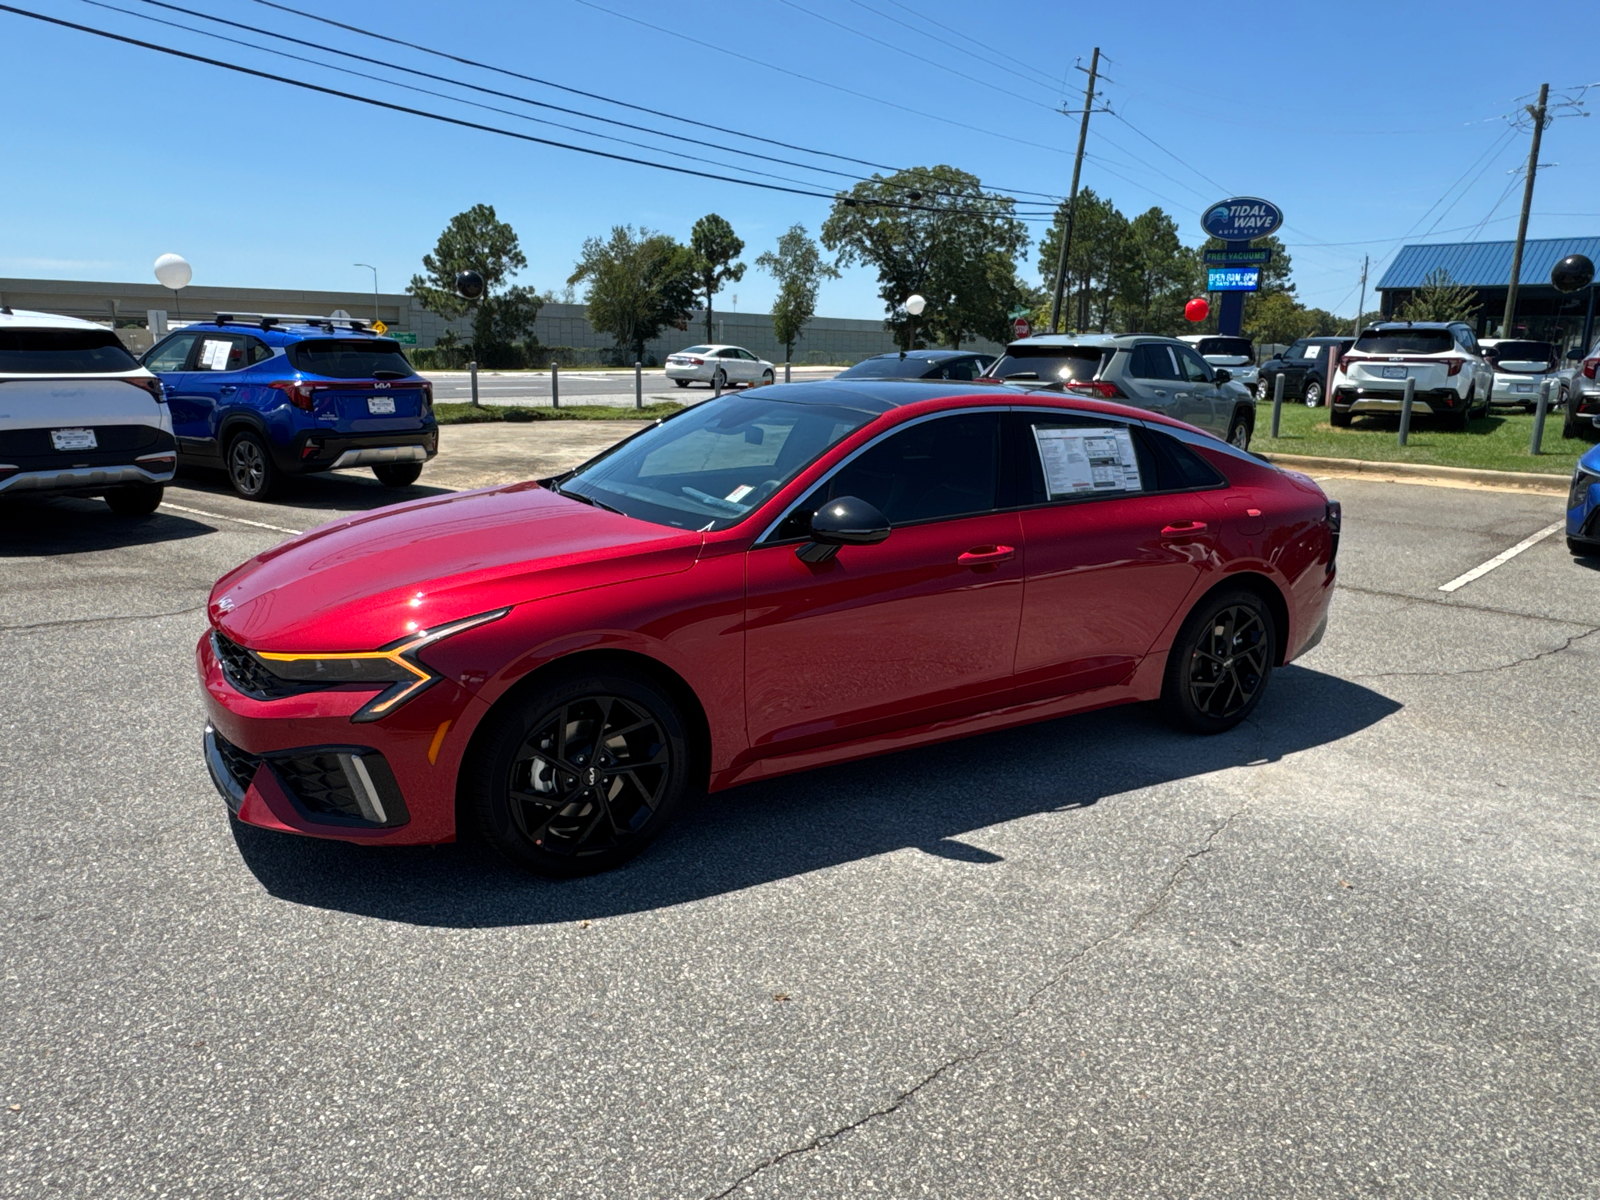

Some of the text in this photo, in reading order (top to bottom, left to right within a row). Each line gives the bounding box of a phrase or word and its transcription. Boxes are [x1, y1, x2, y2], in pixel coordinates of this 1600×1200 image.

[1229, 205, 1266, 217] TIDAL
[1234, 216, 1273, 228] WAVE
[1206, 251, 1265, 260] FREE VACUUMS
[1015, 325, 1028, 334] STOP
